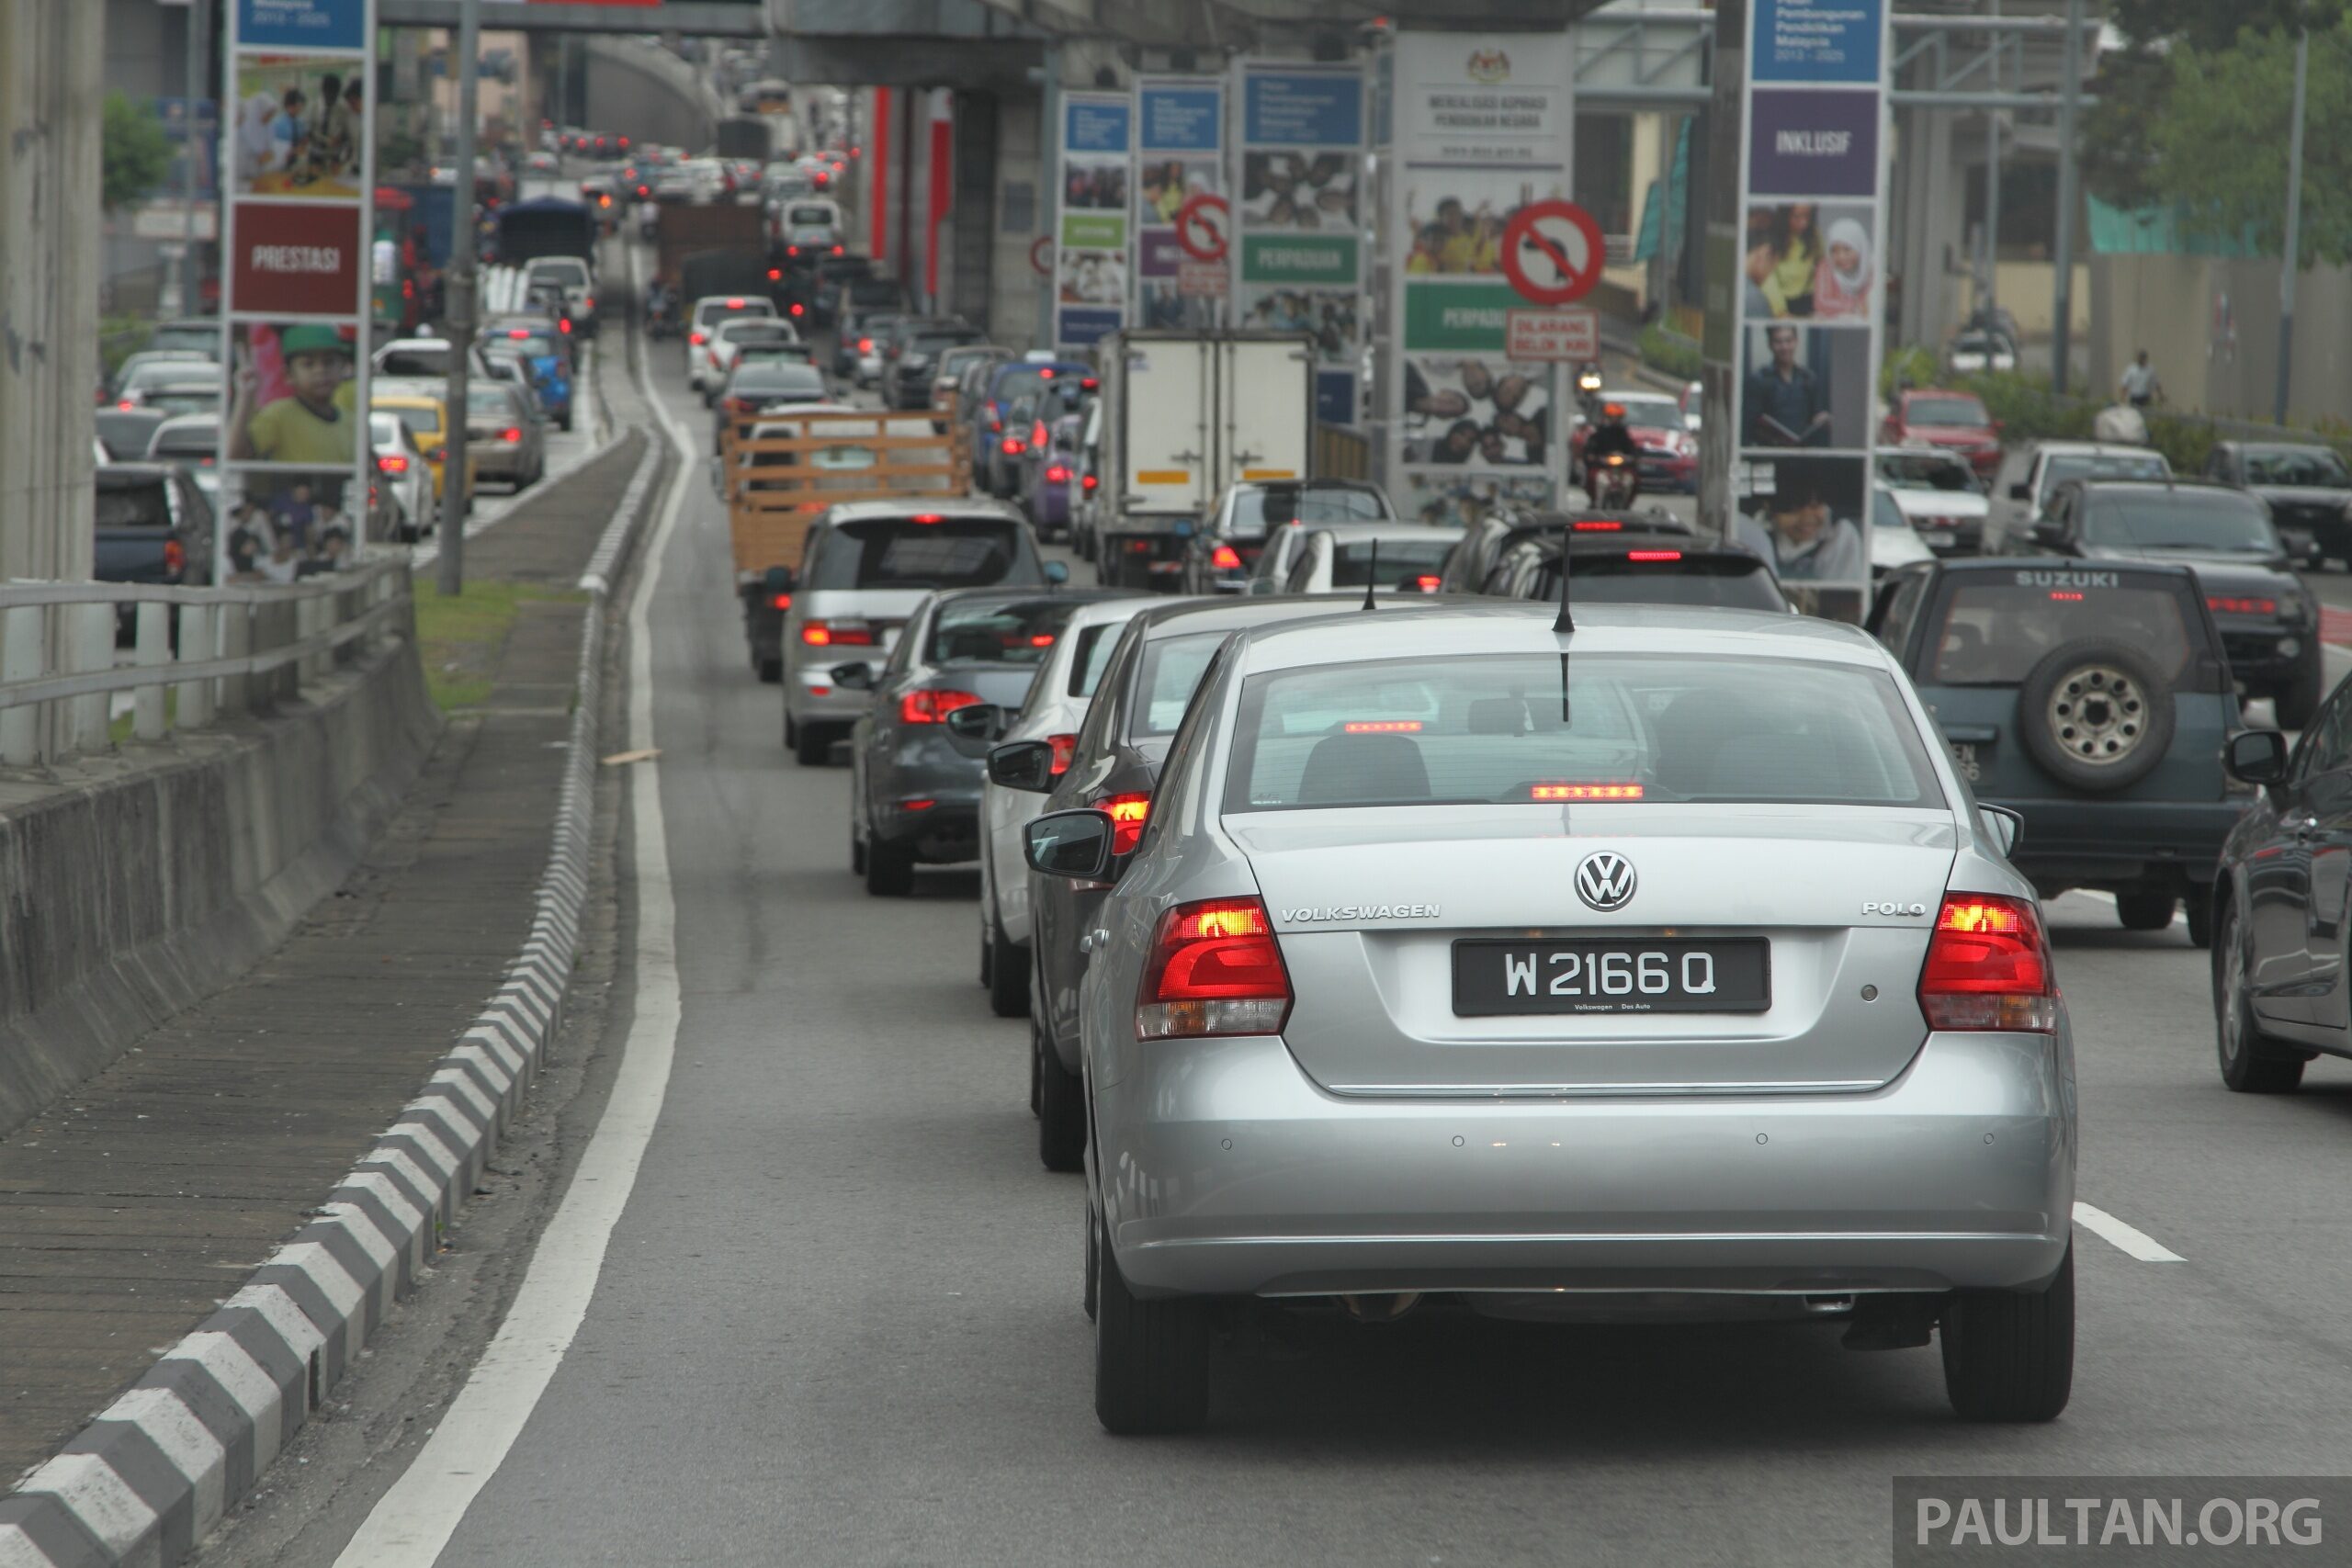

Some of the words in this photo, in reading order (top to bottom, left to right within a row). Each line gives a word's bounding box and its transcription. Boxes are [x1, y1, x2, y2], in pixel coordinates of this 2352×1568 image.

[1776, 35, 1830, 48] Malaysia
[1776, 130, 1852, 156] INKLUSIF
[251, 244, 340, 273] PRESTASI
[2016, 570, 2118, 587] SUZUKI
[1282, 904, 1441, 923] VOLKSWAGEN
[1861, 902, 1926, 917] POLO
[1505, 953, 1537, 996] W
[1549, 952, 1669, 995] 2166
[1681, 952, 1716, 994] Q
